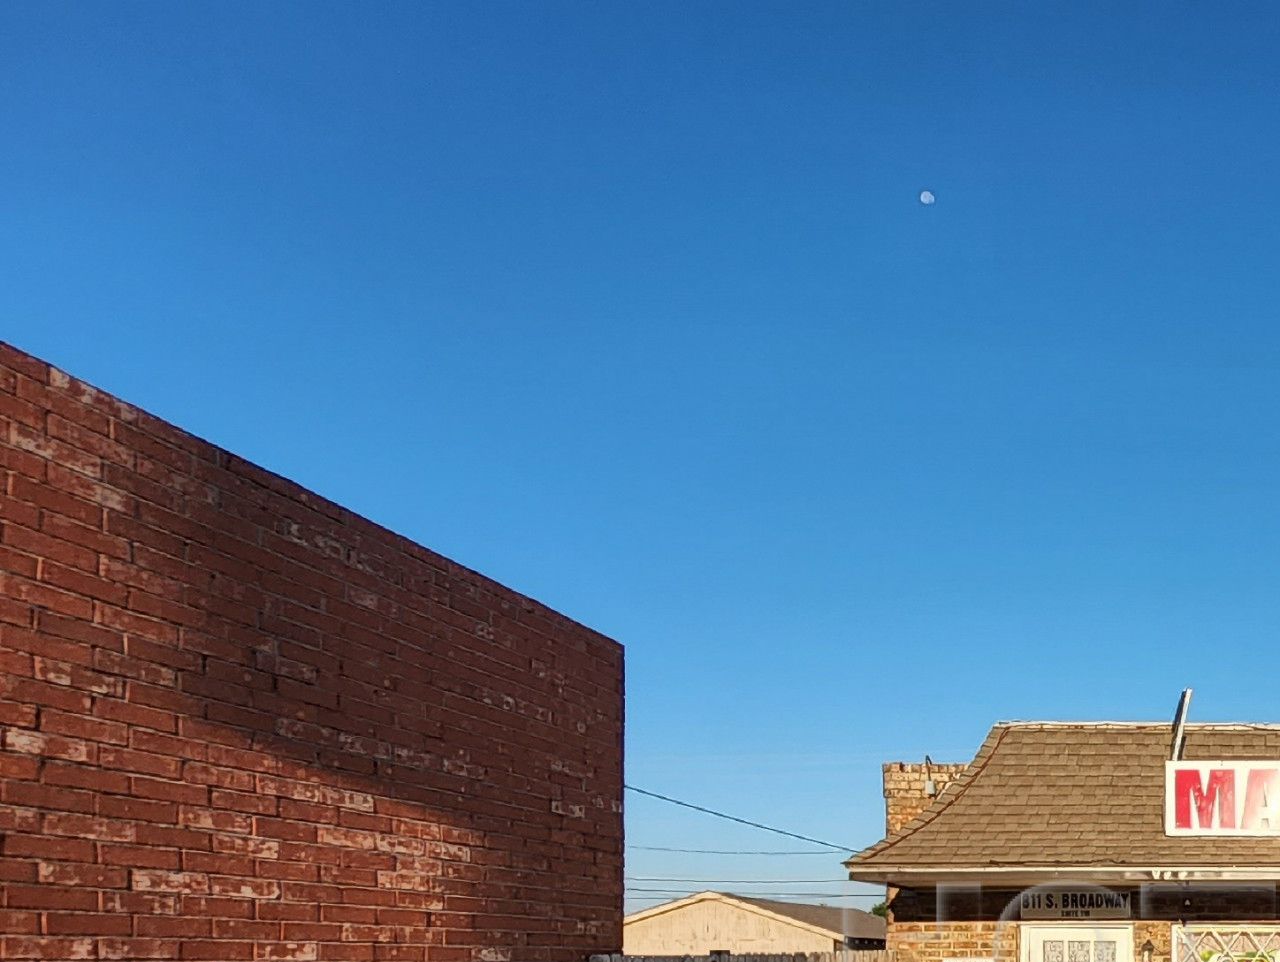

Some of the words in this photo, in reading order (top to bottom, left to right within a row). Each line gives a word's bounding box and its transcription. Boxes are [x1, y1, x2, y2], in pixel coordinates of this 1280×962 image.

[1022, 893, 1042, 909] 811
[1046, 893, 1058, 909] S.
[1062, 893, 1129, 909] BROADWAY
